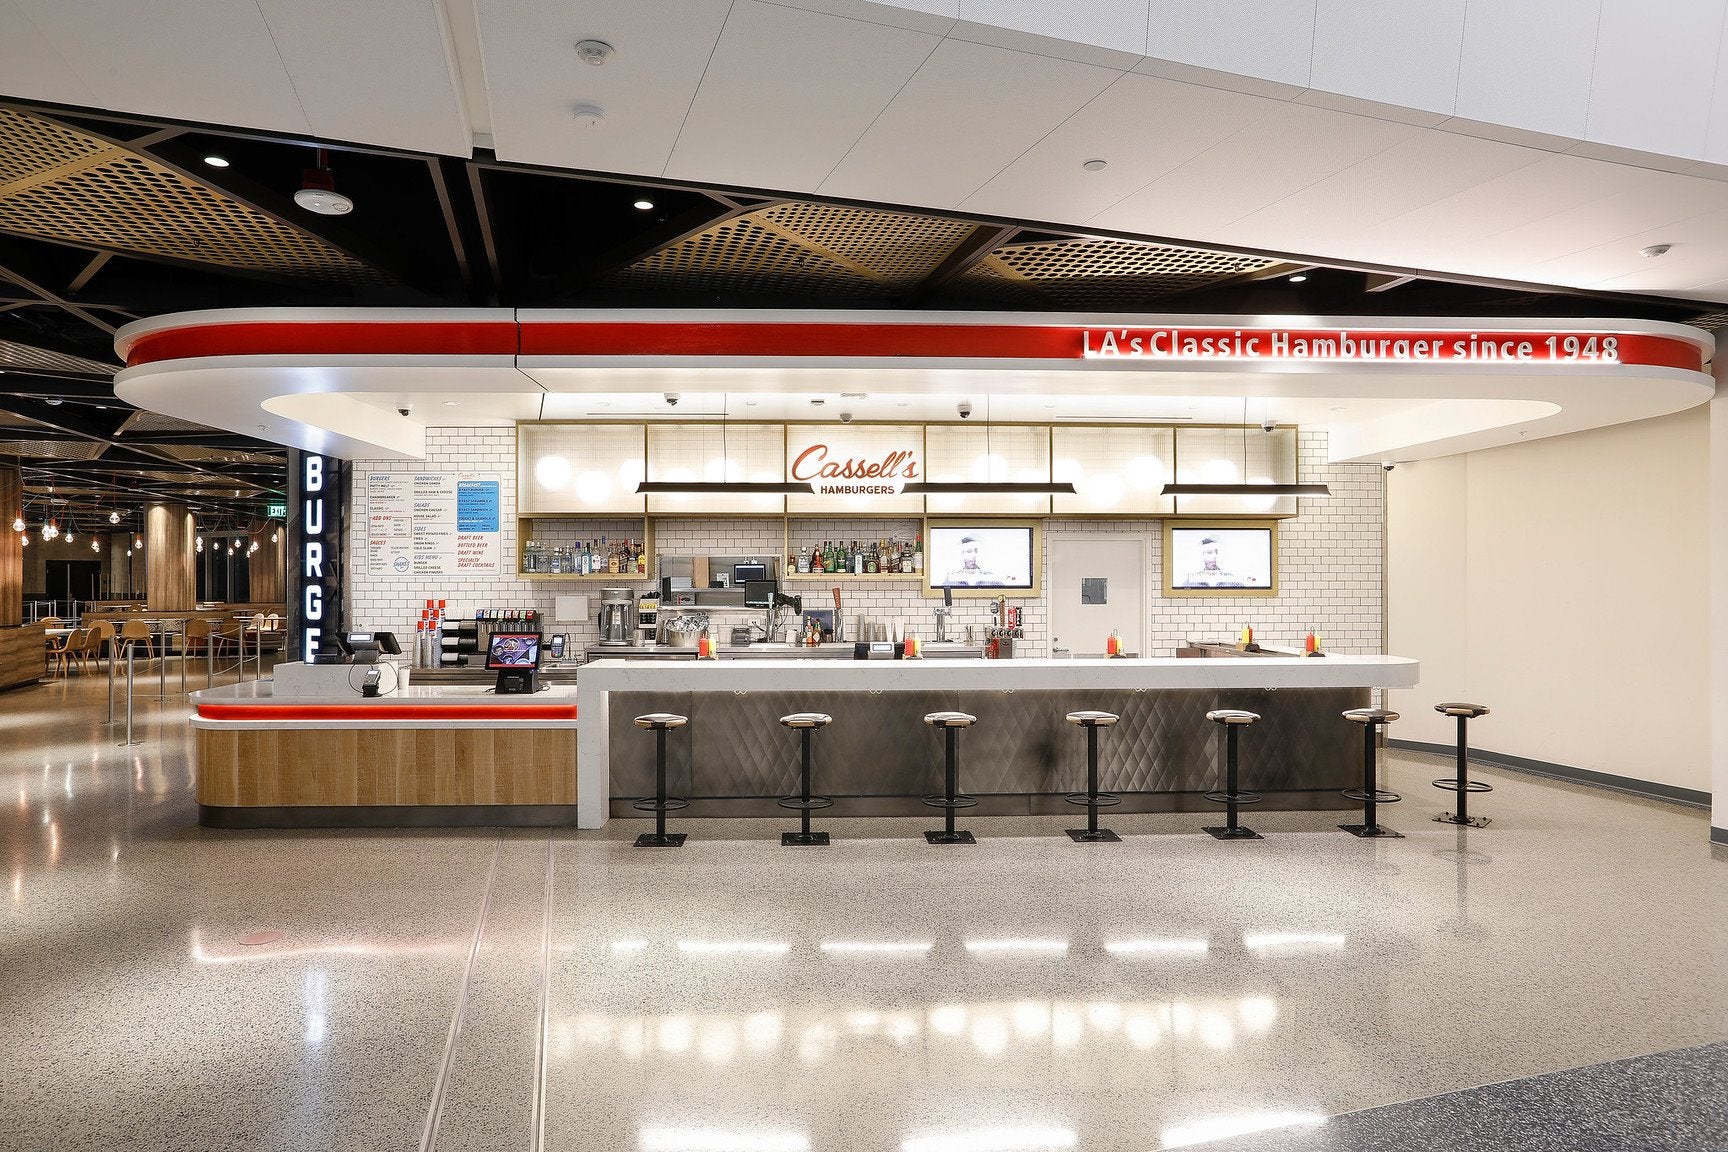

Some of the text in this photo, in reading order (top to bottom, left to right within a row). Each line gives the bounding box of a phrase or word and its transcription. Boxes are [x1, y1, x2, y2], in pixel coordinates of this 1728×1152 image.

[1083, 330, 1618, 362] LA's Classic Hamburger since 1948
[792, 444, 919, 481] Cassell's
[820, 485, 895, 495] HAMBURGERS
